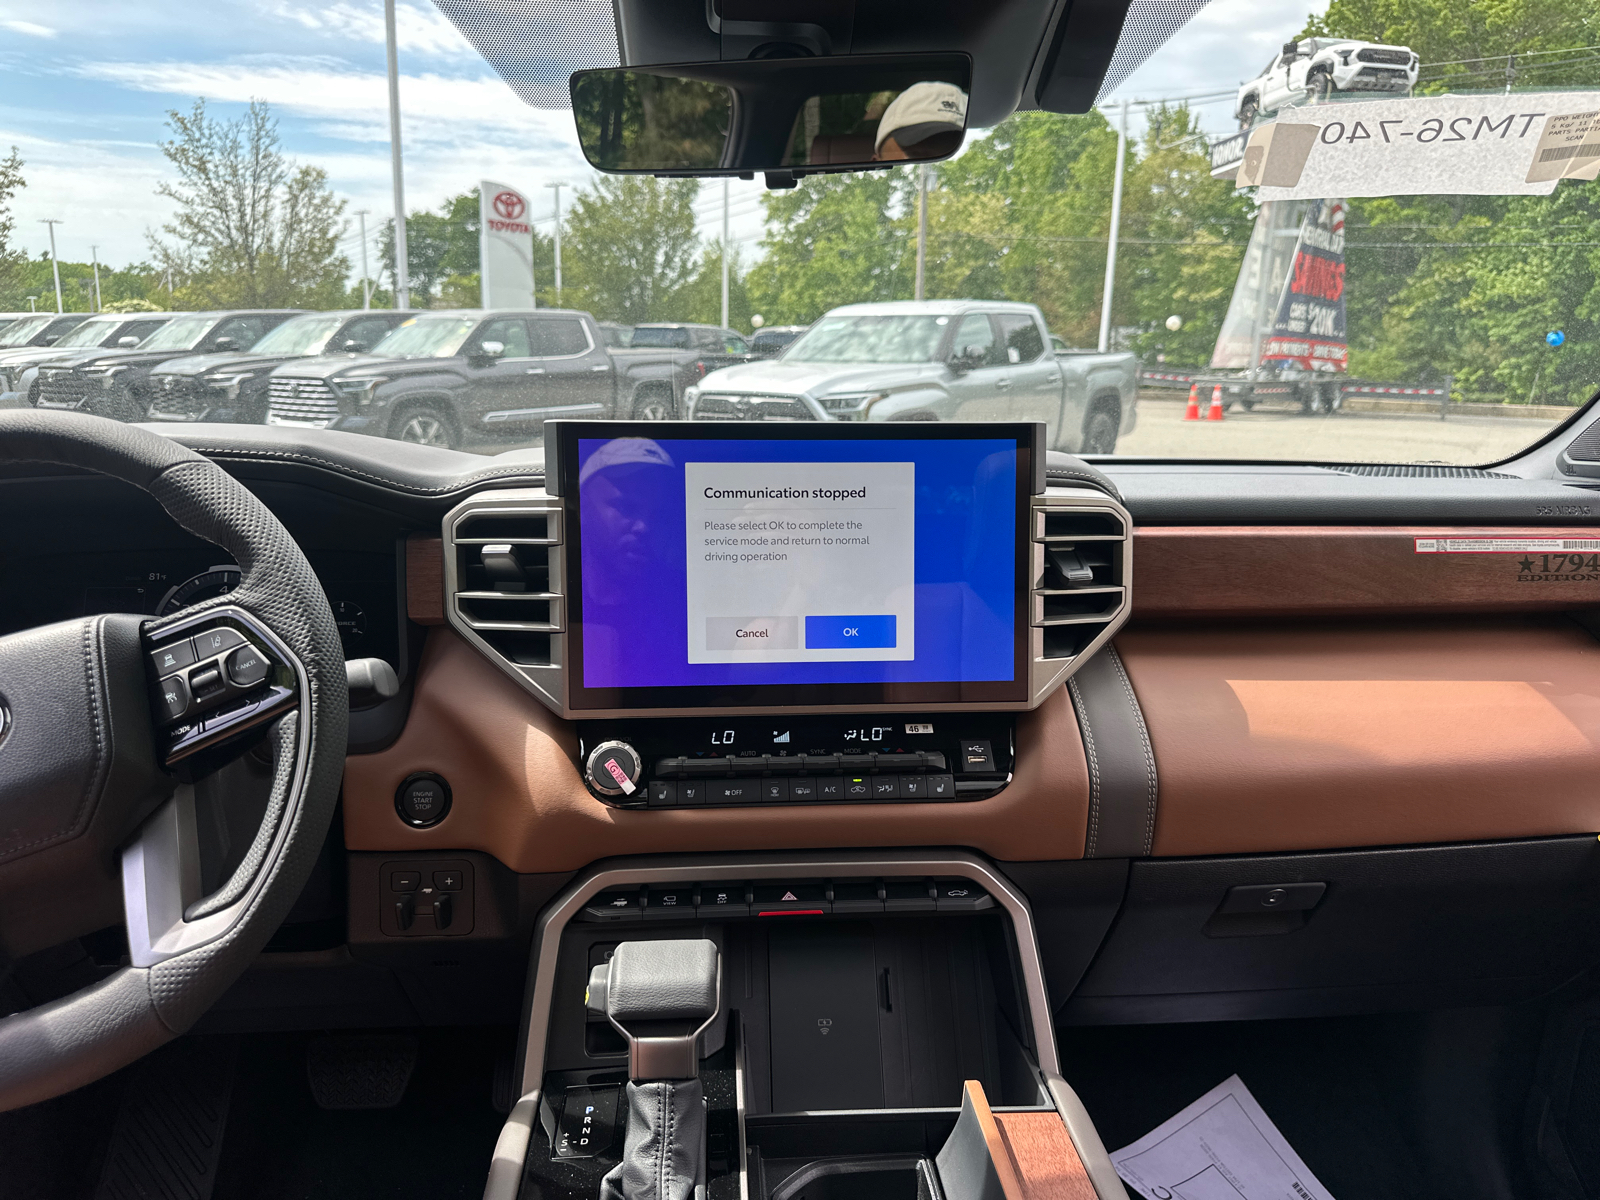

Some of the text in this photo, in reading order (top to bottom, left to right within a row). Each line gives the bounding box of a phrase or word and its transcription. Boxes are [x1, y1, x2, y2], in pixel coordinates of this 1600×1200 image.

[487, 218, 531, 234] TOYOTA
[703, 486, 867, 501] Communication stopped
[1536, 505, 1592, 516] SRS AIRBAG
[704, 520, 863, 533] Please select OK to complete the
[704, 535, 870, 546] service mode and return to normal
[704, 551, 788, 564] driving operation
[1540, 553, 1600, 573] 1794
[1516, 573, 1600, 582] EDITION
[219, 586, 229, 594] 4
[735, 629, 769, 639] Cancel
[842, 627, 859, 638] OK
[235, 659, 257, 671] CANCEL
[171, 725, 191, 738] MODE
[861, 727, 883, 742] LO
[908, 725, 919, 733] 46
[711, 730, 735, 745] LO
[585, 1106, 594, 1114] P
[584, 1116, 592, 1124] R
[580, 1138, 589, 1146] D
